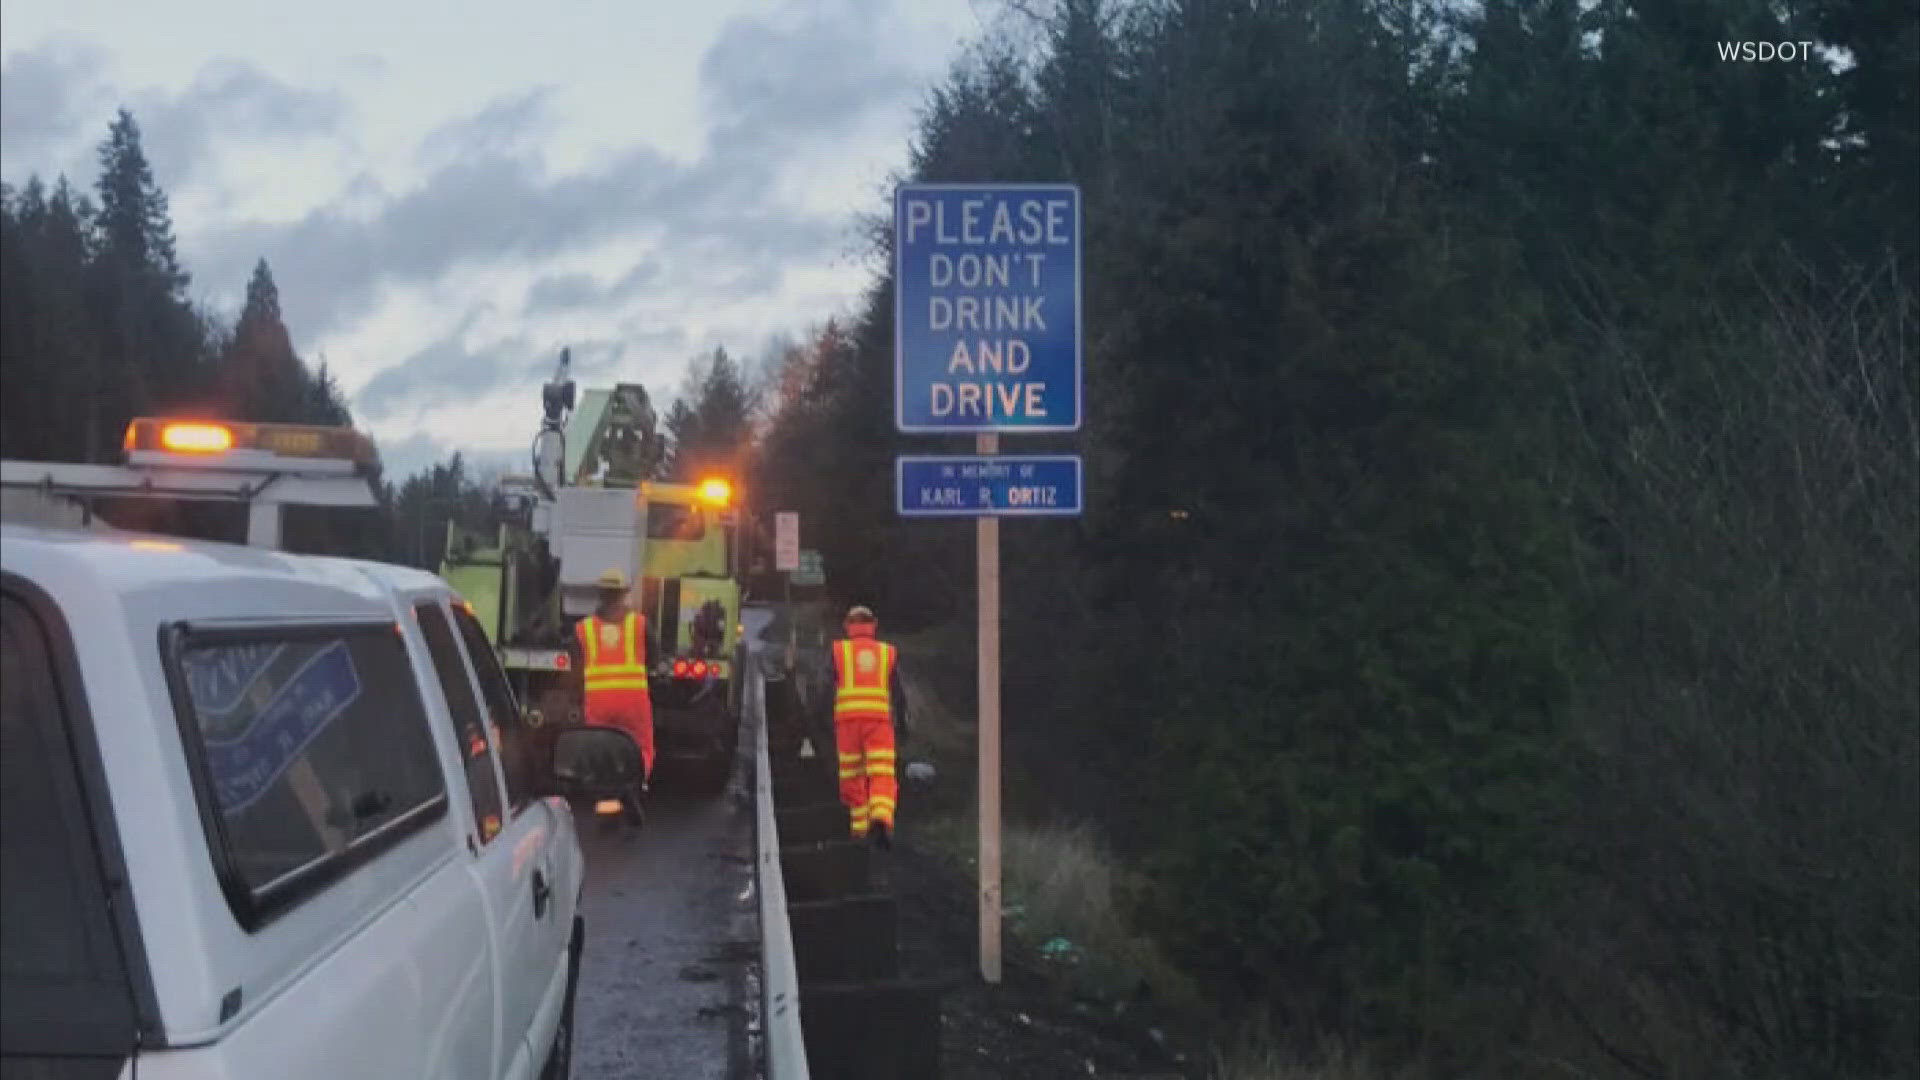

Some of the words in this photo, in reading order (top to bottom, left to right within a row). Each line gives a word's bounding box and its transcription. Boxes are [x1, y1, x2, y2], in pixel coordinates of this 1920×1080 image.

[907, 199, 1069, 245] PLEASE
[929, 252, 1046, 288] DON'T
[929, 295, 1047, 331] DRINK
[948, 338, 1031, 375] AND
[930, 382, 1048, 418] DRIVE
[942, 464, 955, 478] IN
[1020, 464, 1035, 478] OF
[920, 486, 964, 506] KARL
[1008, 486, 1057, 506] ORTIZ
